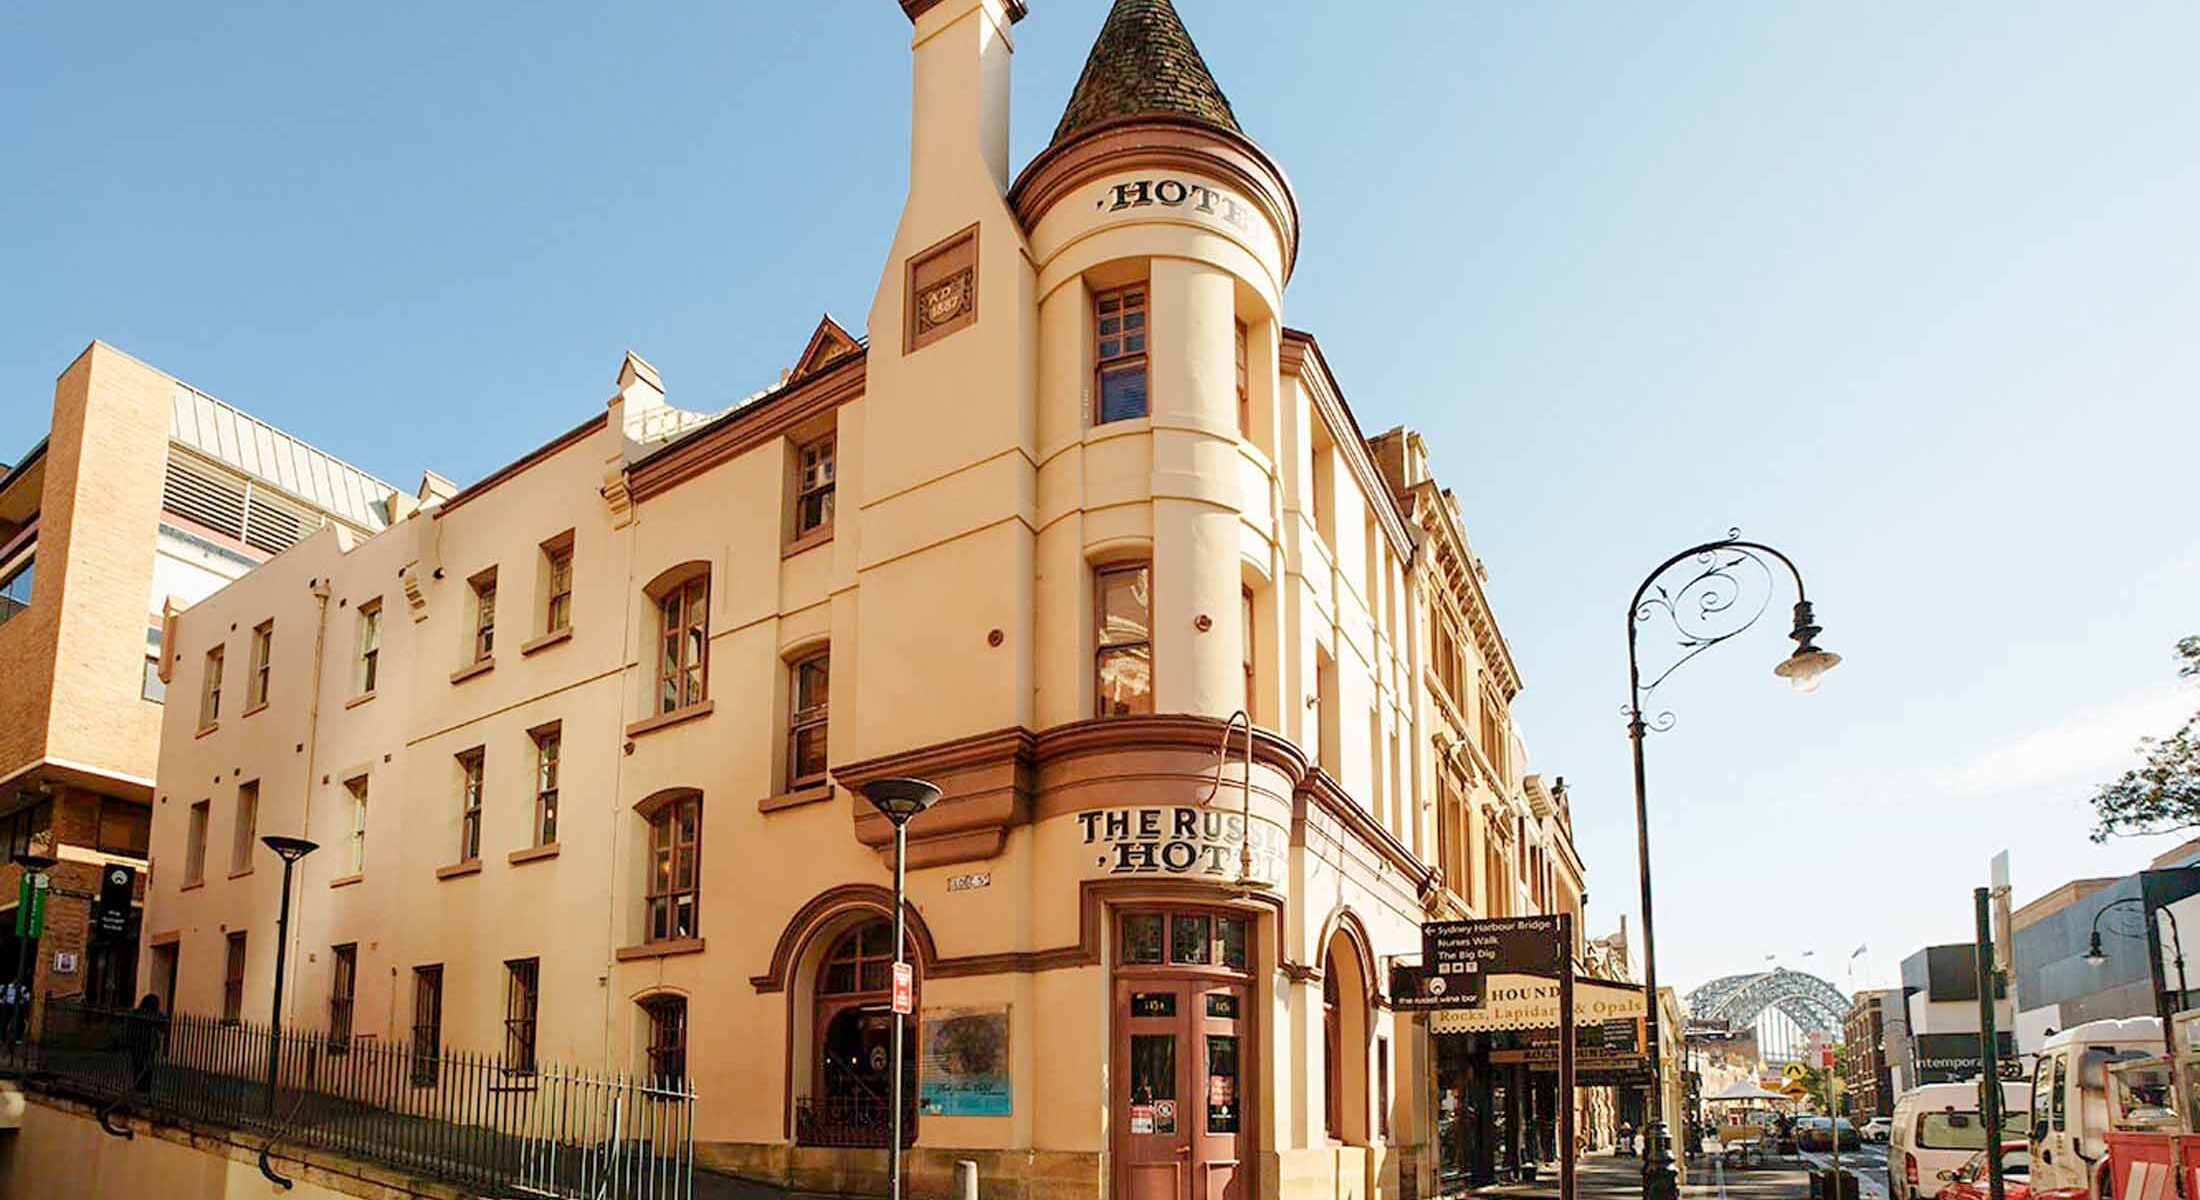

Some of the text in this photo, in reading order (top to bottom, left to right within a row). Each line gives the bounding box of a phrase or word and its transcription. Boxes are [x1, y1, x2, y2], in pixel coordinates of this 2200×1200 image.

[1078, 809, 1161, 844] THE
[1438, 920, 1550, 937] Sydney Harbour Bridge
[1438, 936, 1498, 948] Nurses Walk
[1438, 949, 1496, 961] The Big Dig
[1574, 1003, 1585, 1014] &
[1593, 999, 1643, 1016] Opals
